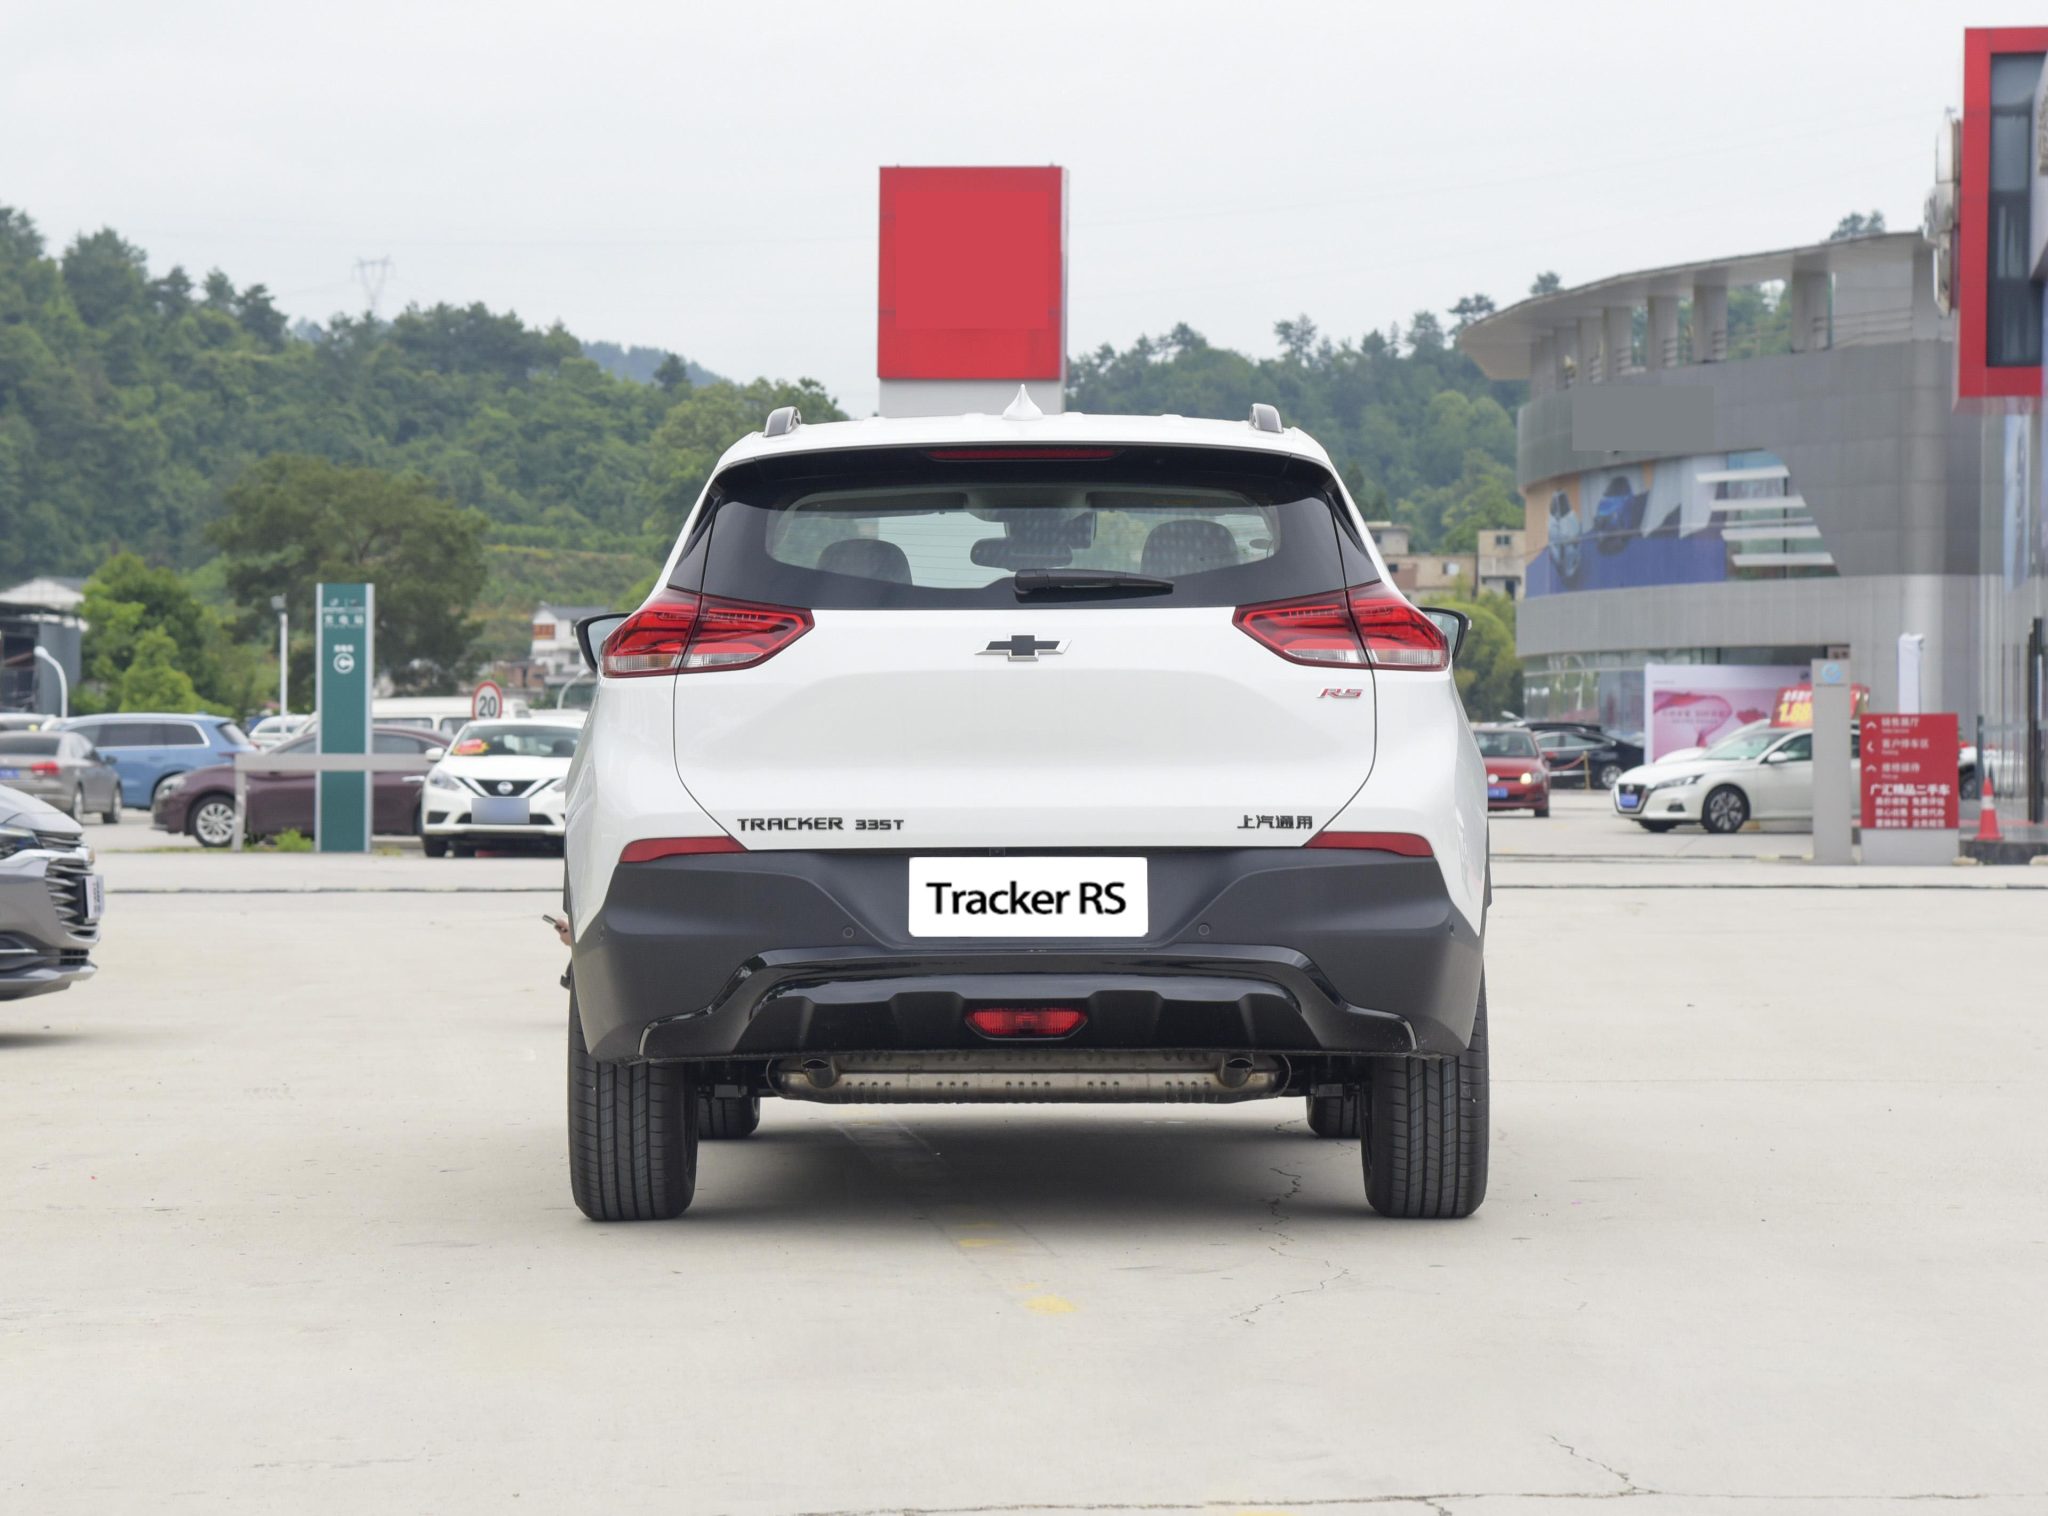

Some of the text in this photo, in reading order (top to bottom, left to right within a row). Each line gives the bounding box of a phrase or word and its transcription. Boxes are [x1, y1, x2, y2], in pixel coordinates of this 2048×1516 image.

[1317, 687, 1363, 699] RS
[479, 696, 497, 717] 20
[737, 817, 904, 831] TRACKER 335T
[1237, 815, 1313, 830] 上汽通用
[926, 881, 1127, 915] Tracker RS
